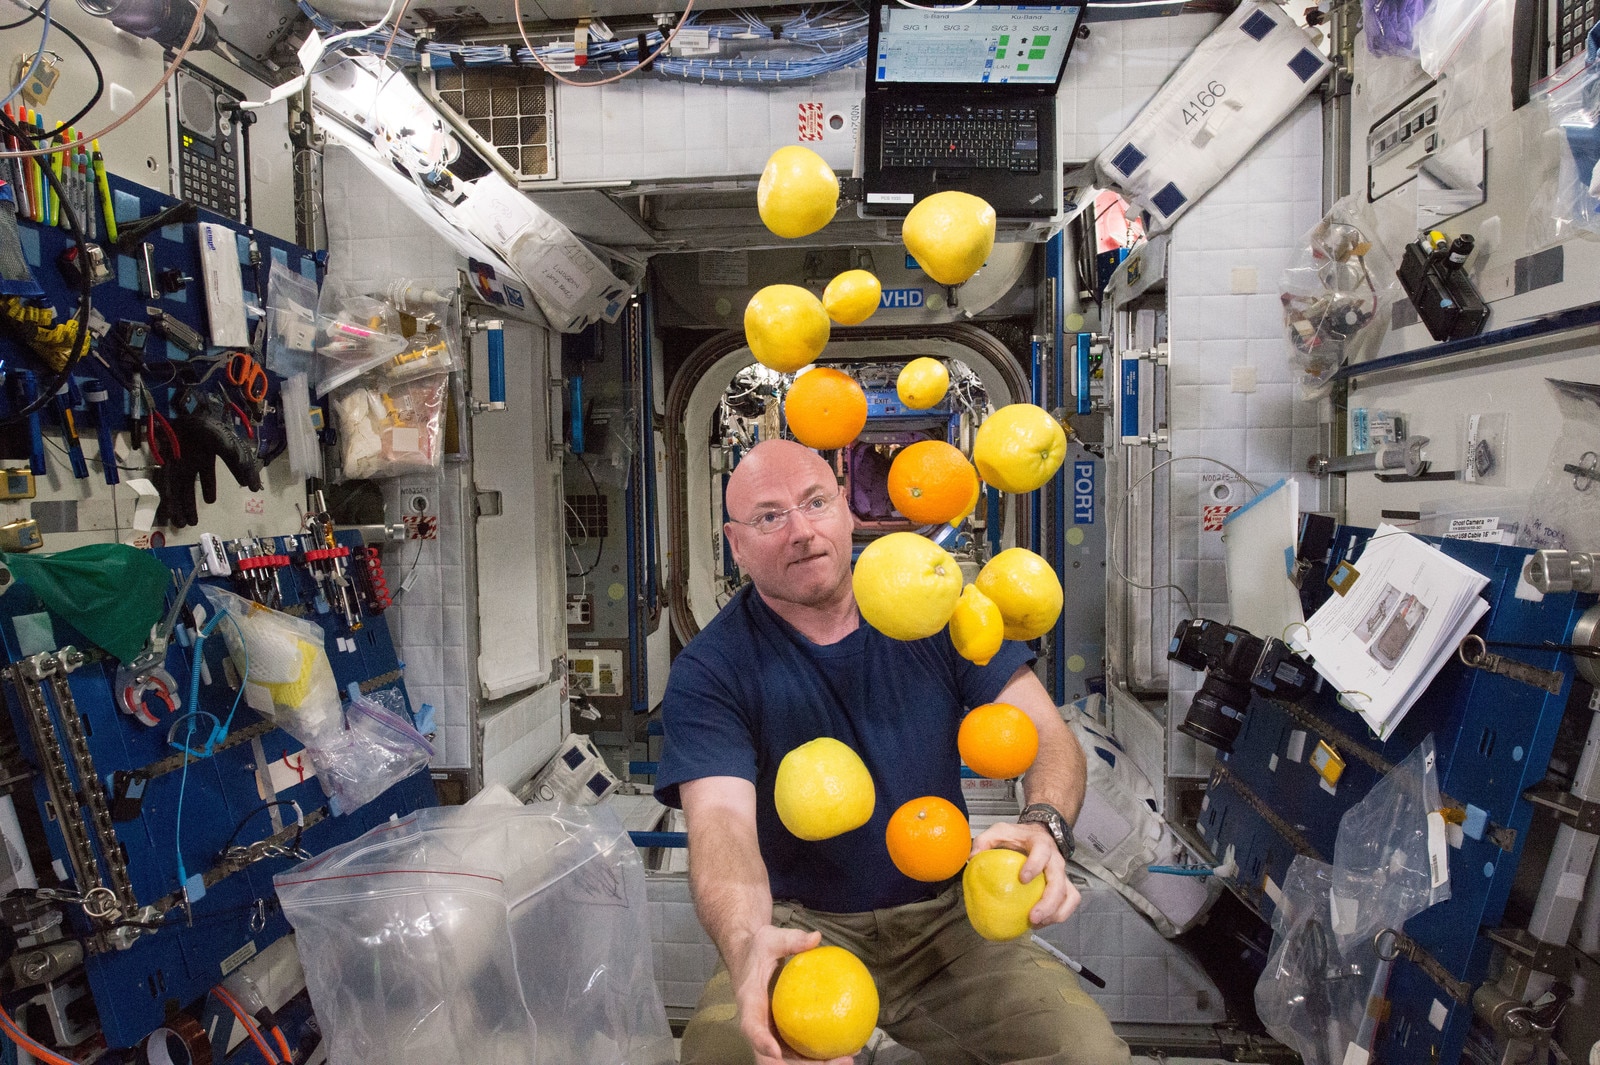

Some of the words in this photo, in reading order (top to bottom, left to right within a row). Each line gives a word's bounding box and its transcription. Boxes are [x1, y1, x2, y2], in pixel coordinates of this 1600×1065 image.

[1182, 80, 1226, 125] 4166
[881, 290, 923, 307] VHD
[1075, 464, 1093, 522] PORT
